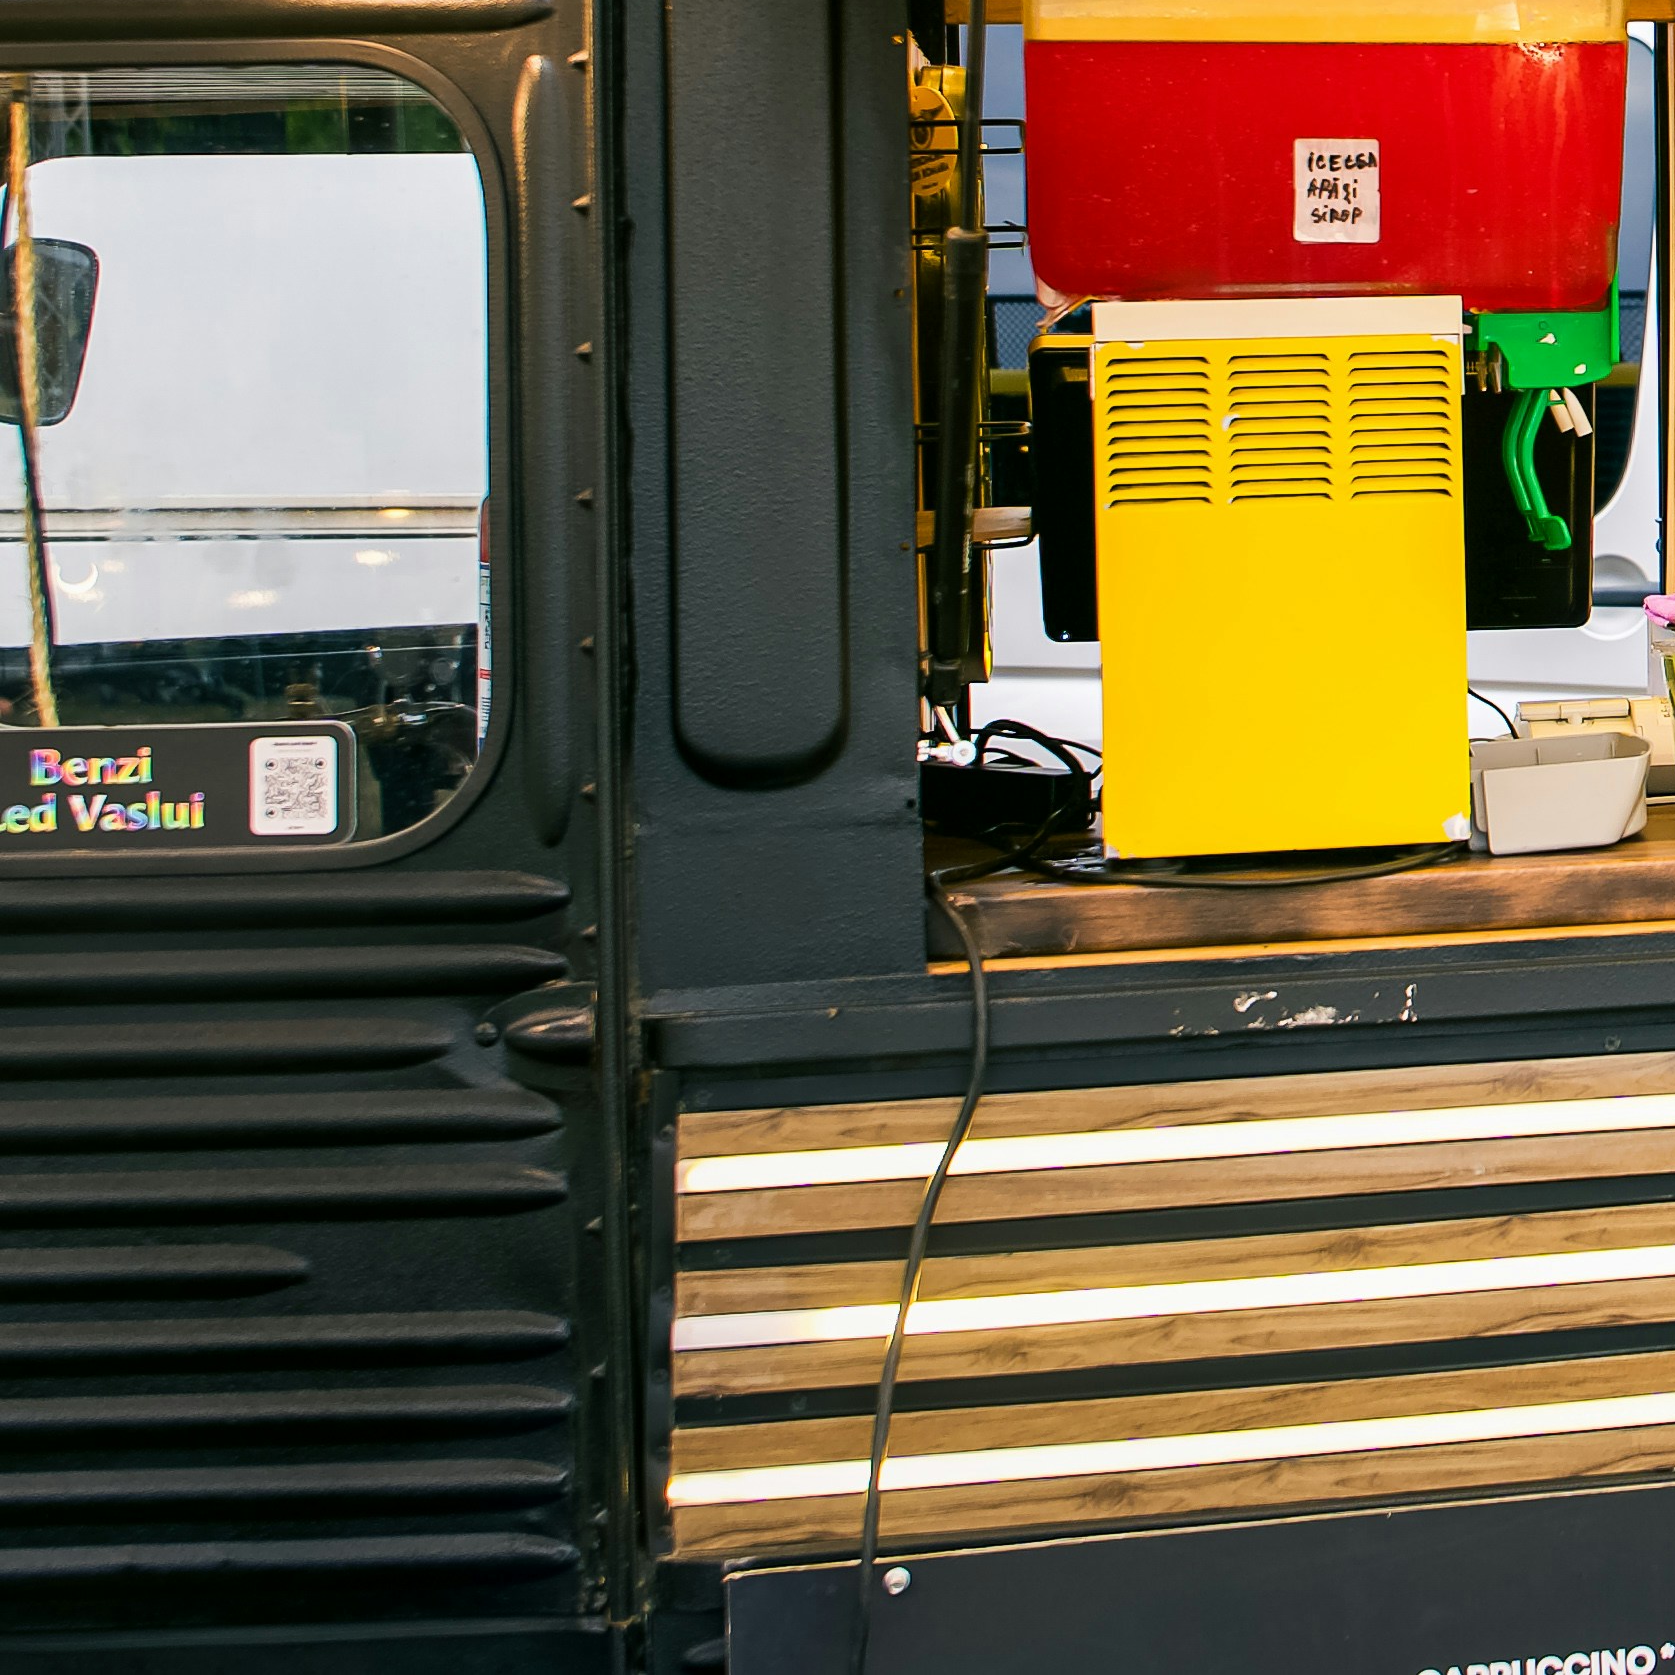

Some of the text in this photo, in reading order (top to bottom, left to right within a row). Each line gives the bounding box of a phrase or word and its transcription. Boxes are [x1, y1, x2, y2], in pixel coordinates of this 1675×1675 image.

[29, 746, 153, 786] Benzi
[0, 790, 205, 834] ed Vaslui
